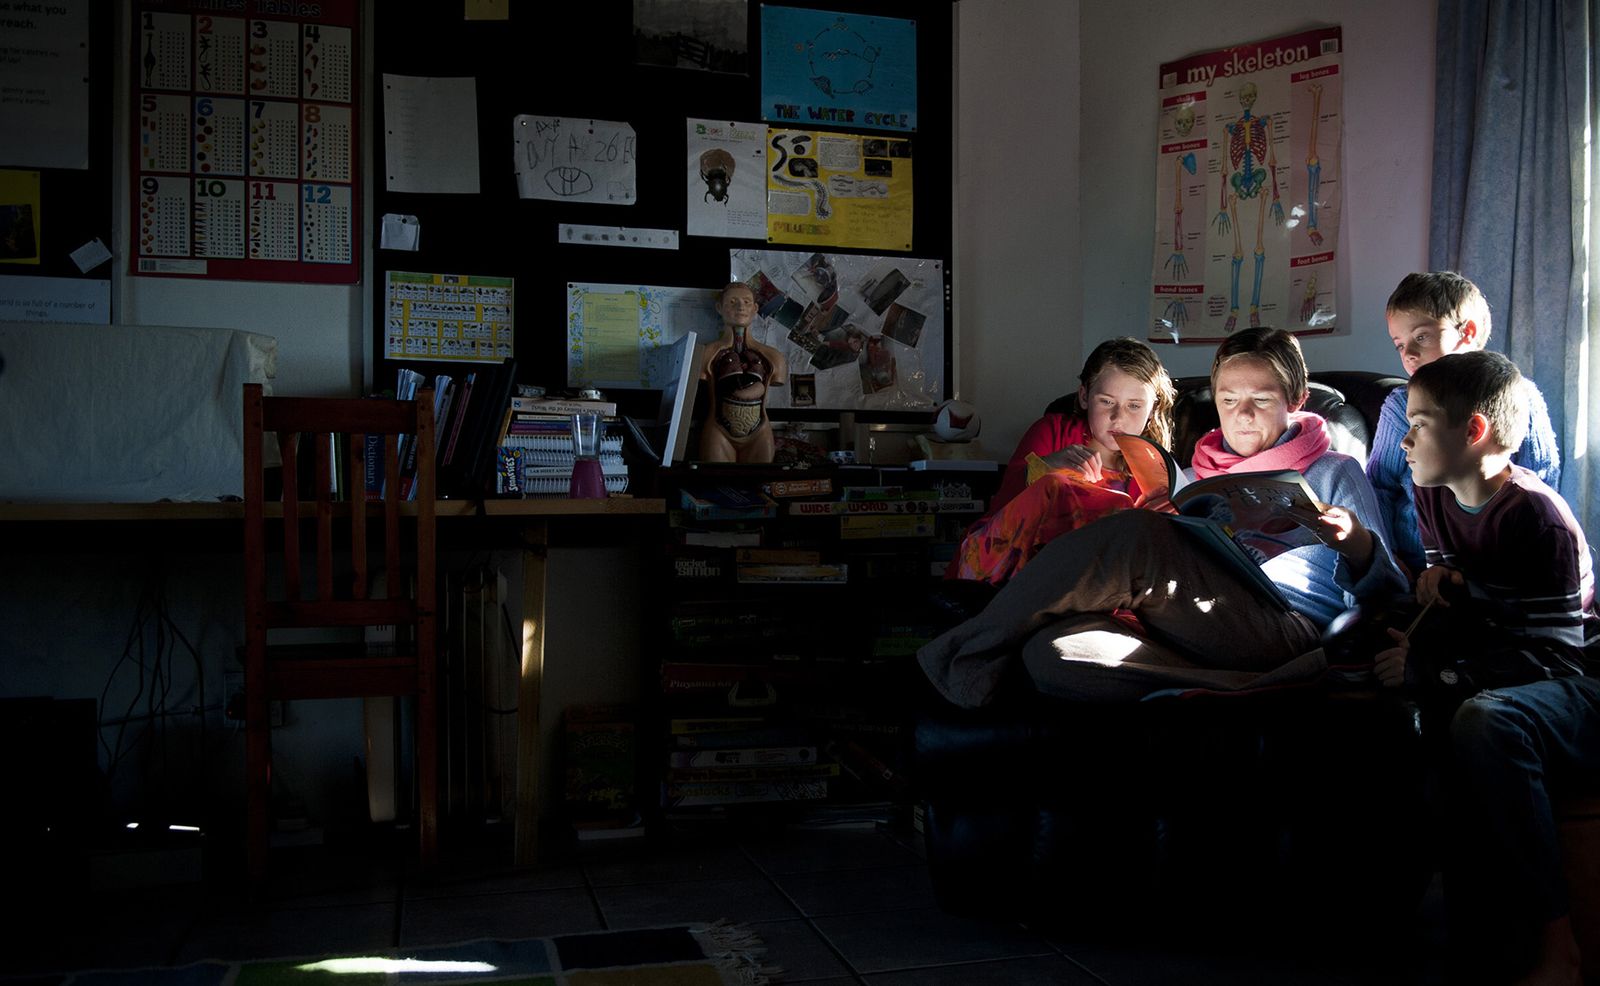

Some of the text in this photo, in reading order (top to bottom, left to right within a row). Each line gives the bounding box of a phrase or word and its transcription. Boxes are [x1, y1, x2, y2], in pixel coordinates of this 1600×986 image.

[13, 1, 42, 13] what
[46, 6, 67, 16] you
[143, 13, 154, 30] 1
[199, 16, 213, 34] 2
[252, 21, 268, 38] 3
[305, 25, 320, 43] 4
[1187, 45, 1309, 87] my skeleton
[1311, 68, 1330, 78] bones
[142, 95, 157, 112] 5
[197, 98, 213, 116] 6
[252, 101, 265, 119] 7
[305, 105, 321, 123] 8
[774, 103, 908, 128] THE WATER CYCLE
[142, 178, 159, 195] 9
[197, 179, 226, 197] 10
[252, 183, 276, 200] 11
[305, 186, 331, 204] 12
[366, 435, 379, 485] Dictionary
[799, 501, 889, 514] WIDE WORLD
[677, 567, 721, 577] simon
